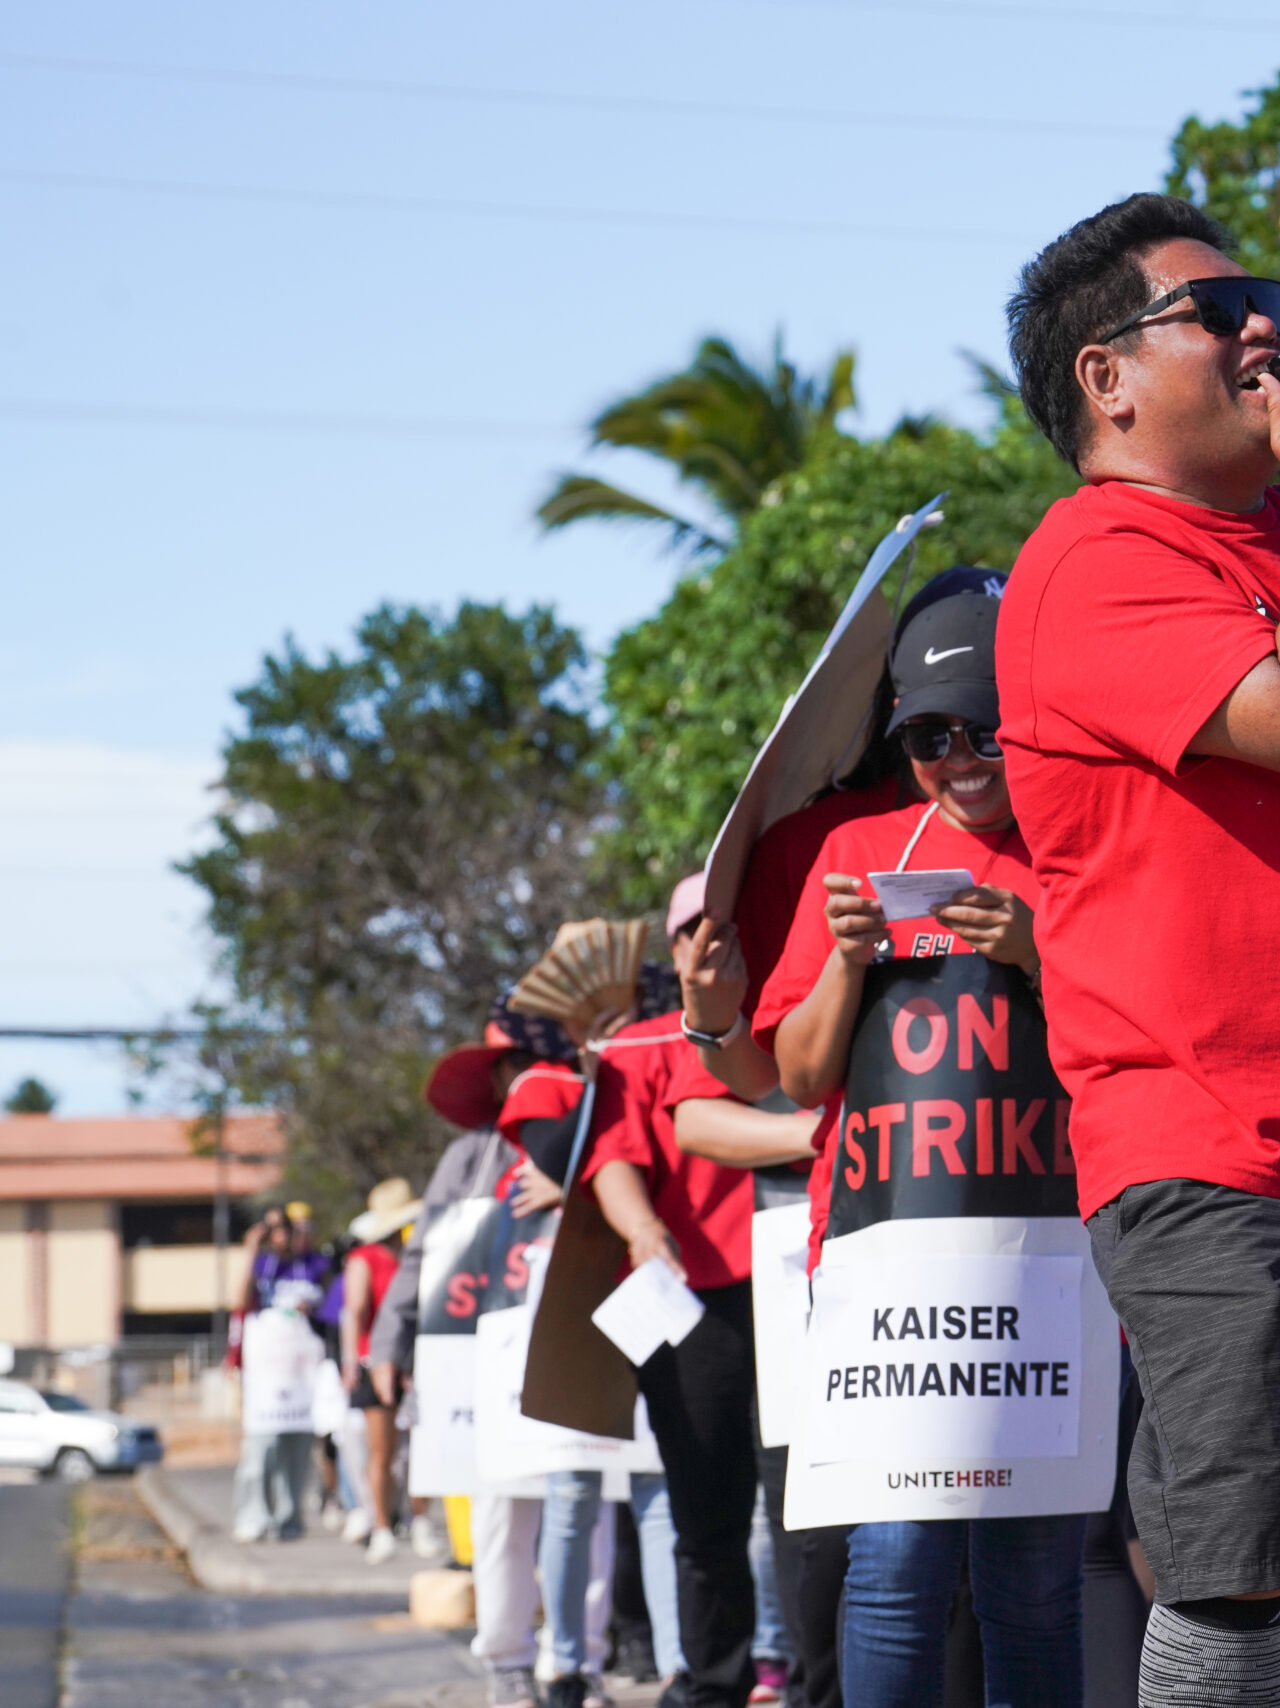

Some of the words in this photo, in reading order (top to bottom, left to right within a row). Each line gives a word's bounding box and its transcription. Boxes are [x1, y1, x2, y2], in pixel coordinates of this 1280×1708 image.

[891, 993, 1009, 1075] ON
[844, 1098, 1078, 1191] STRIKE
[872, 1306, 1020, 1341] KAISER
[826, 1362, 1070, 1401] PERMANENTE
